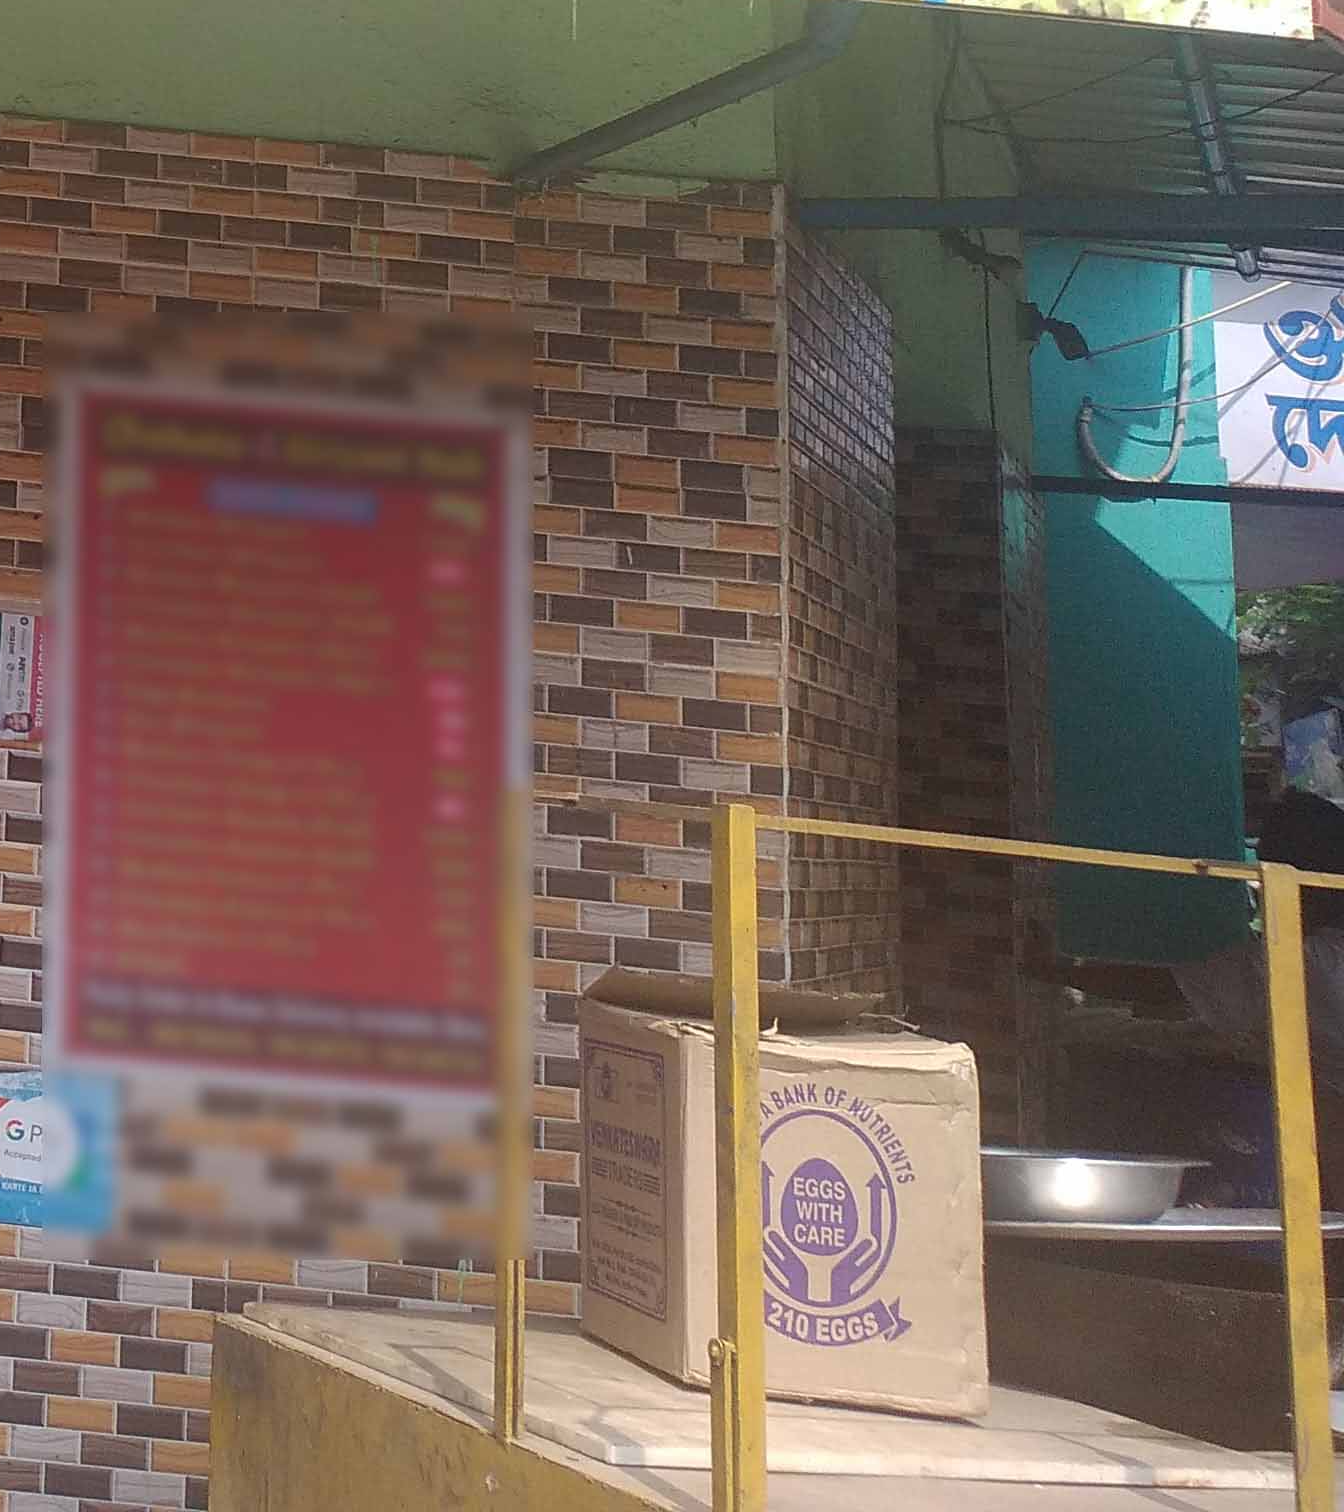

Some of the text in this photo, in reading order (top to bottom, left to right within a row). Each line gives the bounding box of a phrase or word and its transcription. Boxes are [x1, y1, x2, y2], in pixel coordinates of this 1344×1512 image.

[773, 1082, 819, 1110] BANK
[824, 1085, 848, 1109] OF
[849, 1096, 917, 1186] NUTRIENTS
[793, 1176, 847, 1202] EGGS
[795, 1201, 843, 1225] WITH
[794, 1225, 846, 1249] CARE
[767, 1302, 880, 1343] 210 EGGS
